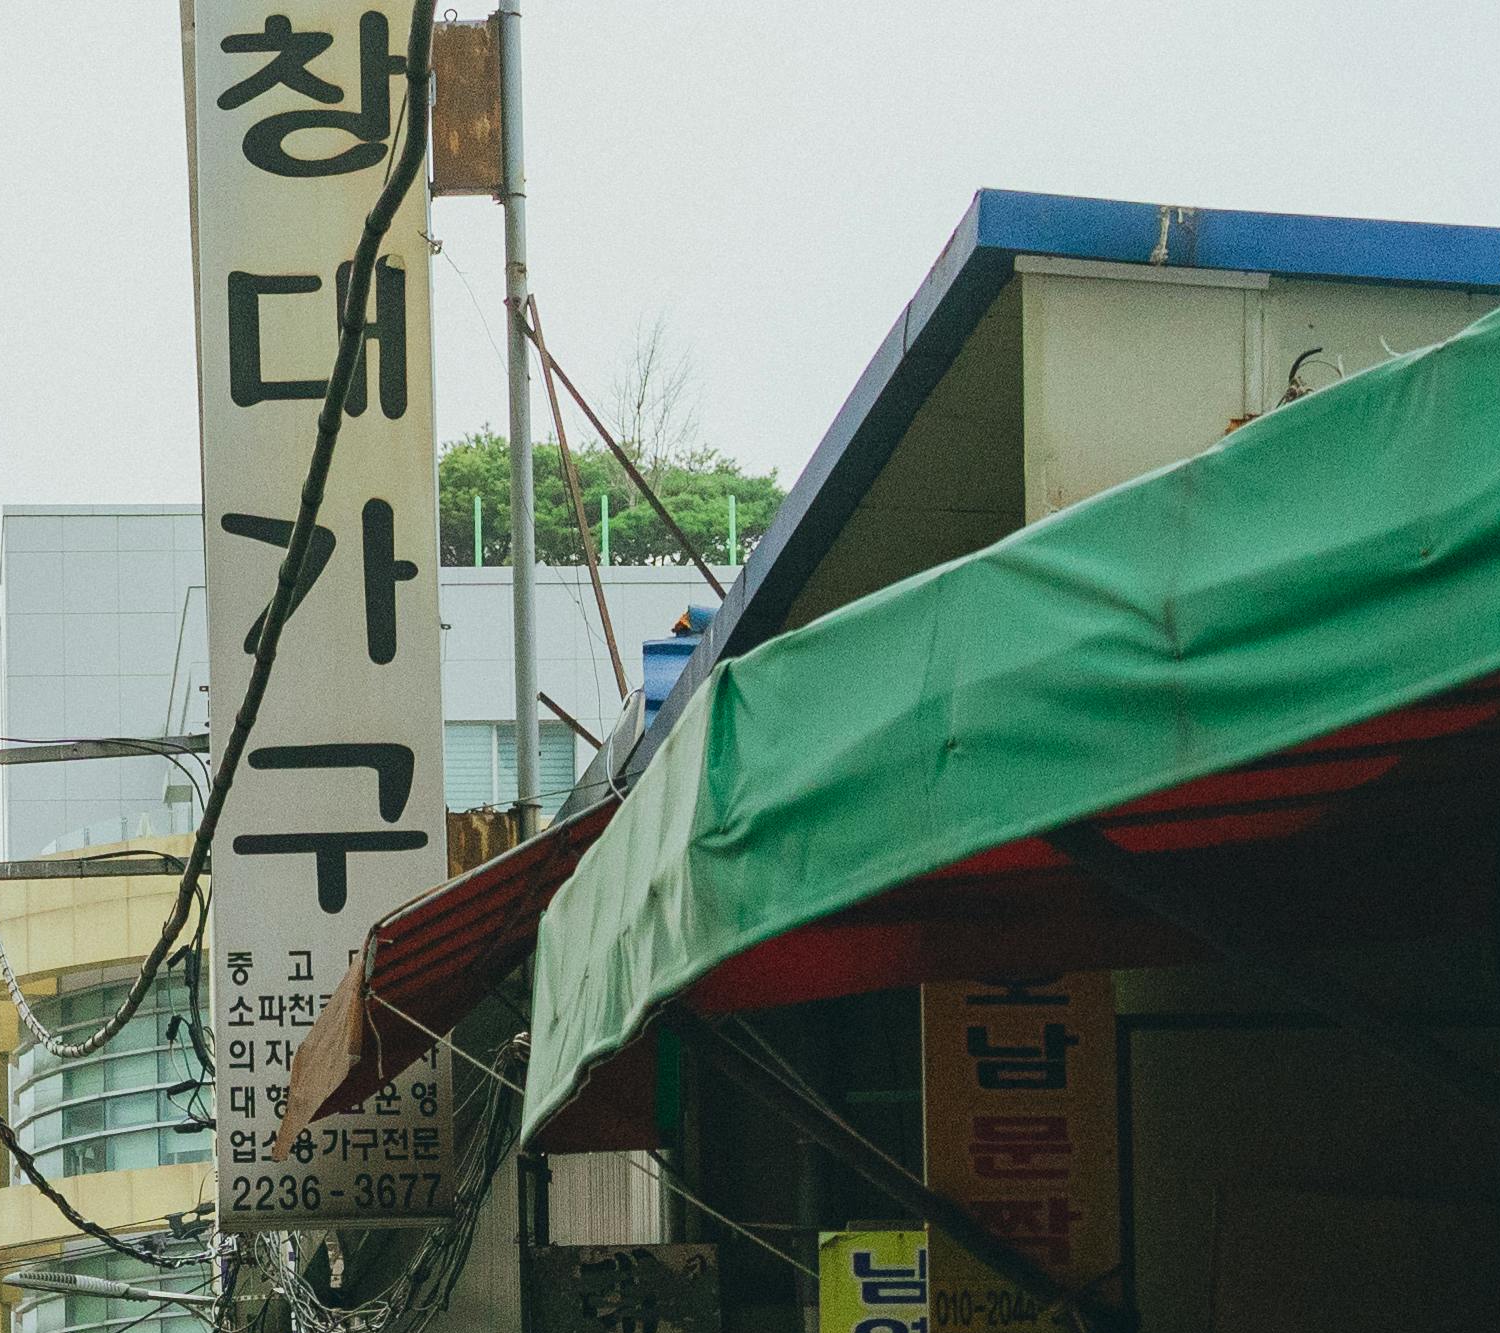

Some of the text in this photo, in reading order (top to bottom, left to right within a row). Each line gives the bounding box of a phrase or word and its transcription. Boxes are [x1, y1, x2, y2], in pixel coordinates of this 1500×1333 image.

[216, 10, 429, 915] 창대가구
[228, 993, 334, 1028] 소파천
[232, 1172, 442, 1212] 2236-3677
